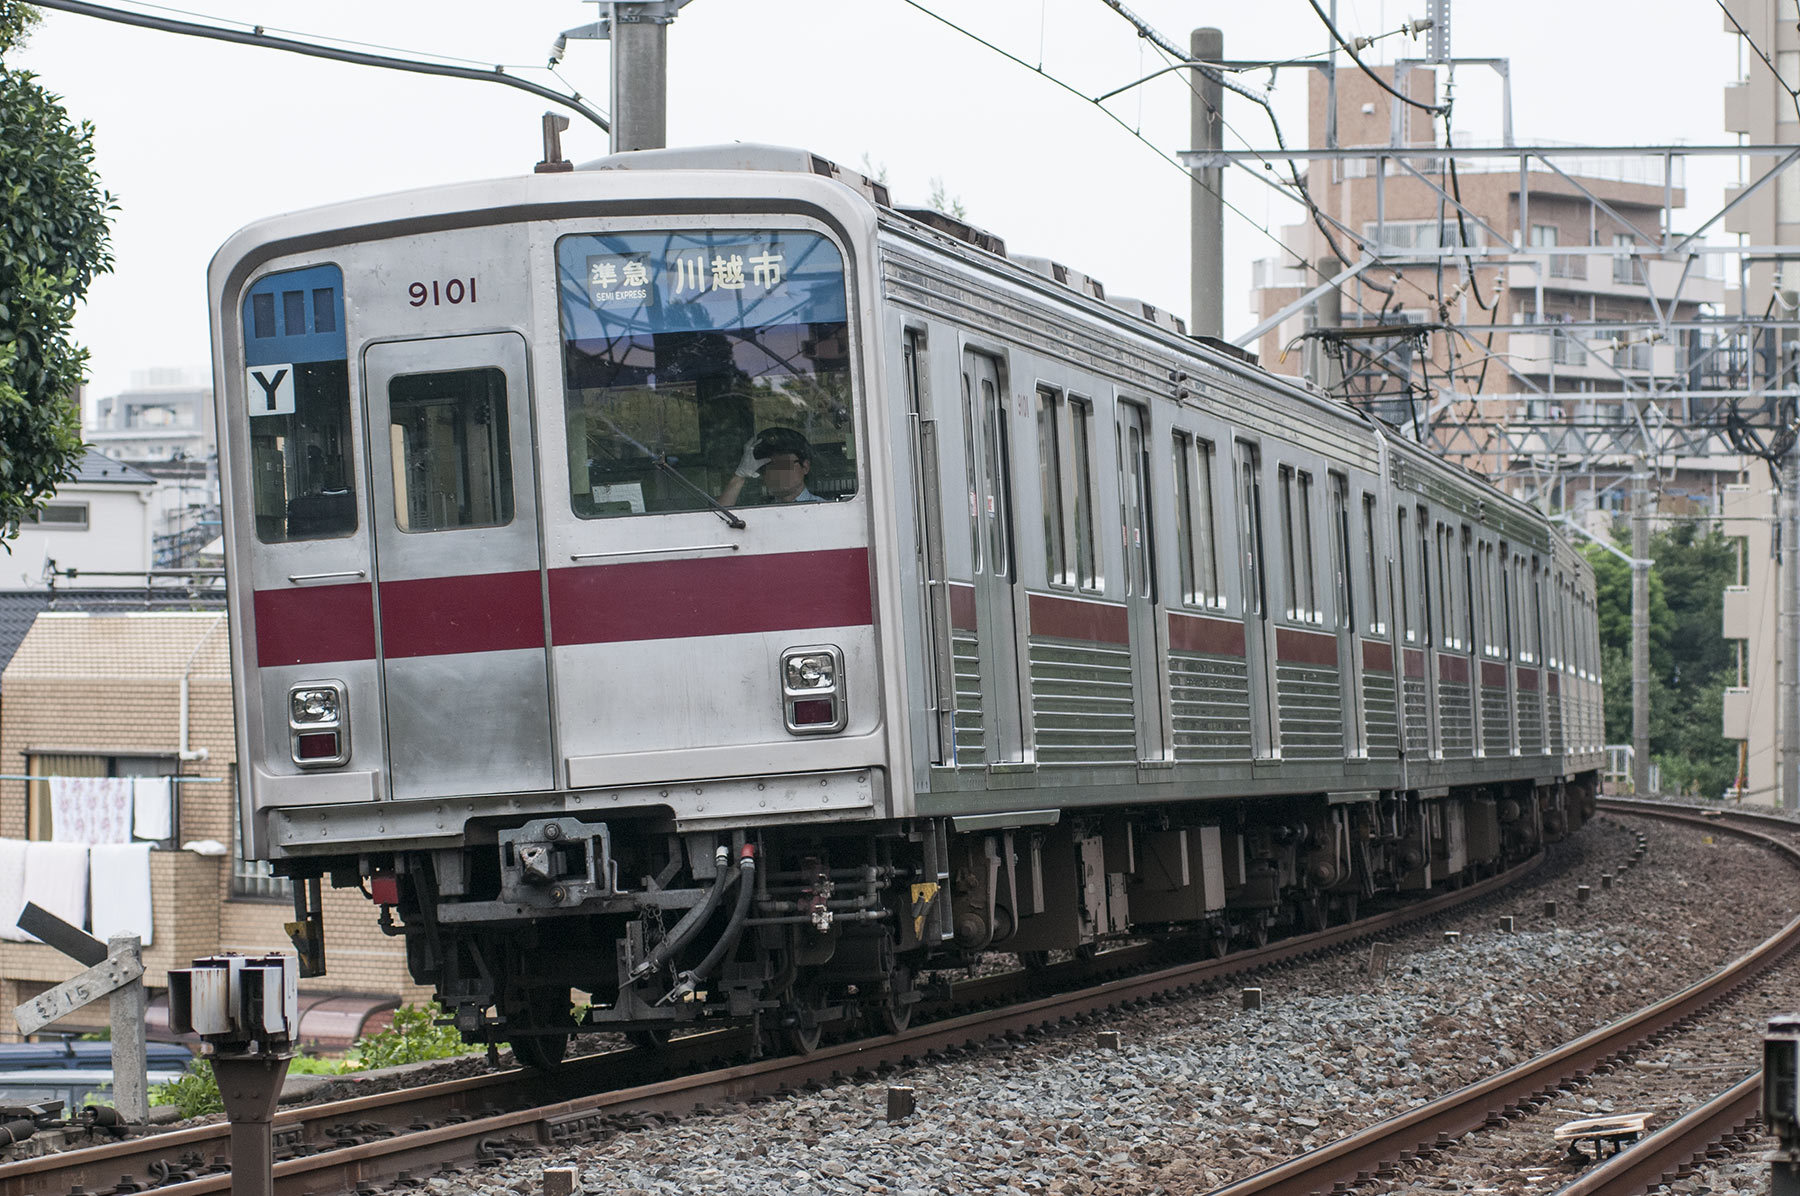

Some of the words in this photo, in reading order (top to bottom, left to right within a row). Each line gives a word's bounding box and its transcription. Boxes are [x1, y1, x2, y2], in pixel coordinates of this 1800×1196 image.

[591, 260, 649, 288] 準急
[676, 250, 783, 294] 川越市
[408, 277, 477, 307] 9101
[596, 291, 615, 302] SEMI
[615, 289, 647, 301] EXPRESS
[251, 369, 289, 411] Y
